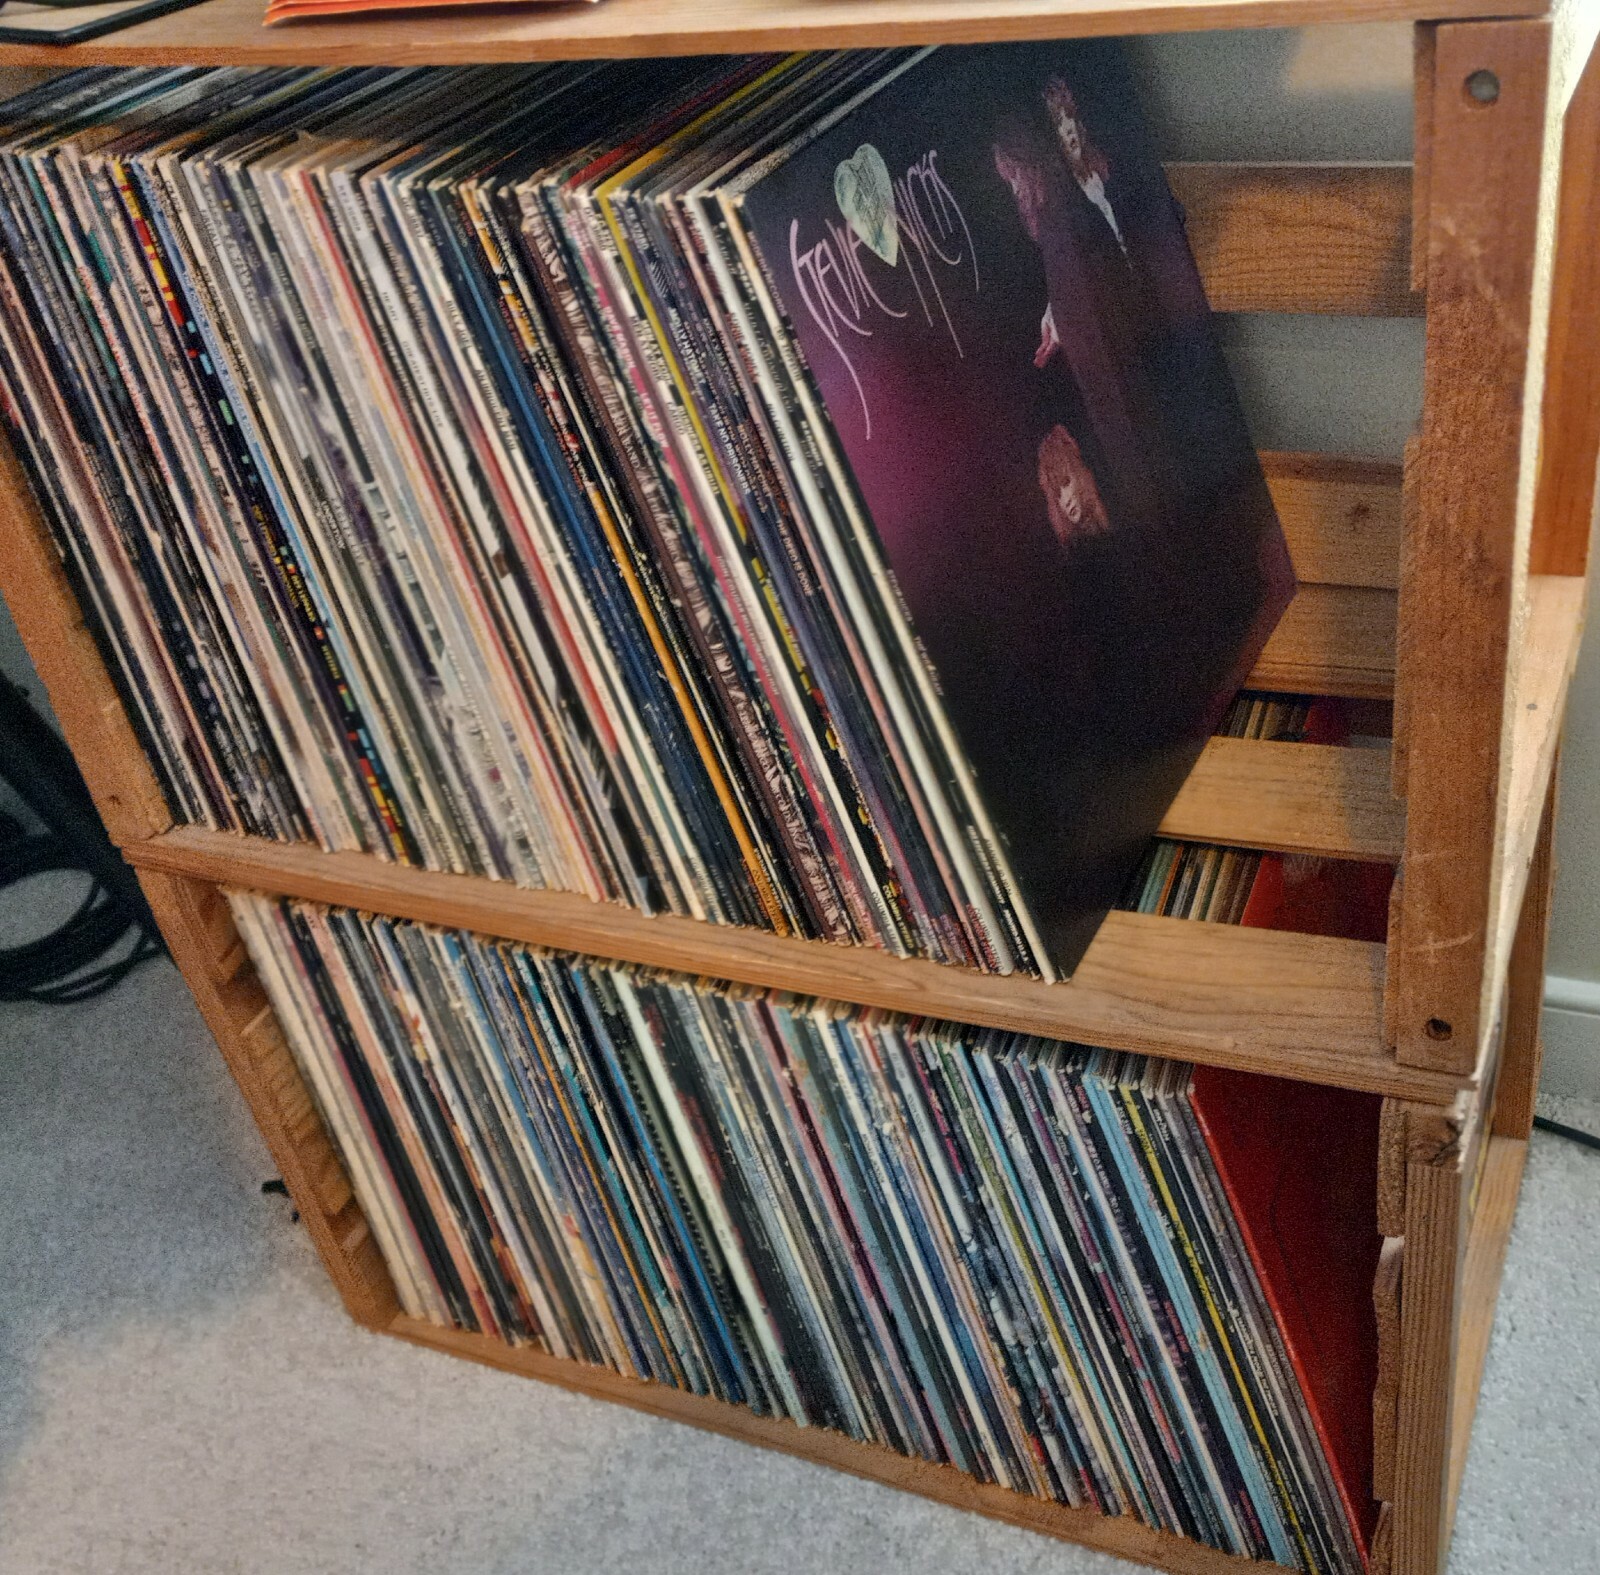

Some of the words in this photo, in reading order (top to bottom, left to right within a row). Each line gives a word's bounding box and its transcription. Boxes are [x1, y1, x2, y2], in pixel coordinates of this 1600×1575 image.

[380, 291, 399, 322] HEART
[763, 273, 788, 317] RECORDS
[602, 306, 620, 333] DAVE
[628, 315, 645, 338] MEN
[640, 319, 656, 340] MEN
[667, 308, 688, 340] MOLLY
[614, 333, 635, 368] MASON
[639, 340, 651, 353] AT
[649, 342, 662, 354] AT
[445, 299, 462, 326] BILLY
[456, 327, 472, 349] JOEL
[500, 429, 516, 451] MAN
[644, 354, 664, 382] WORK
[655, 355, 675, 385] WORK
[681, 340, 707, 384] HATCHET
[639, 392, 654, 411] LET
[647, 411, 658, 421] IT
[707, 403, 724, 427] TAKE
[664, 401, 686, 436] CARGO
[651, 422, 670, 449] FLOW
[717, 427, 730, 442] NO
[723, 442, 752, 494] PRISONERS
[735, 424, 755, 456] MOLLY
[748, 456, 773, 497] HATCHET
[781, 537, 798, 561] DEED
[795, 571, 813, 597] DONE
[751, 868, 772, 904] COLUMBIA
[881, 884, 903, 921] COLUMBIA
[896, 921, 915, 949] STEREO
